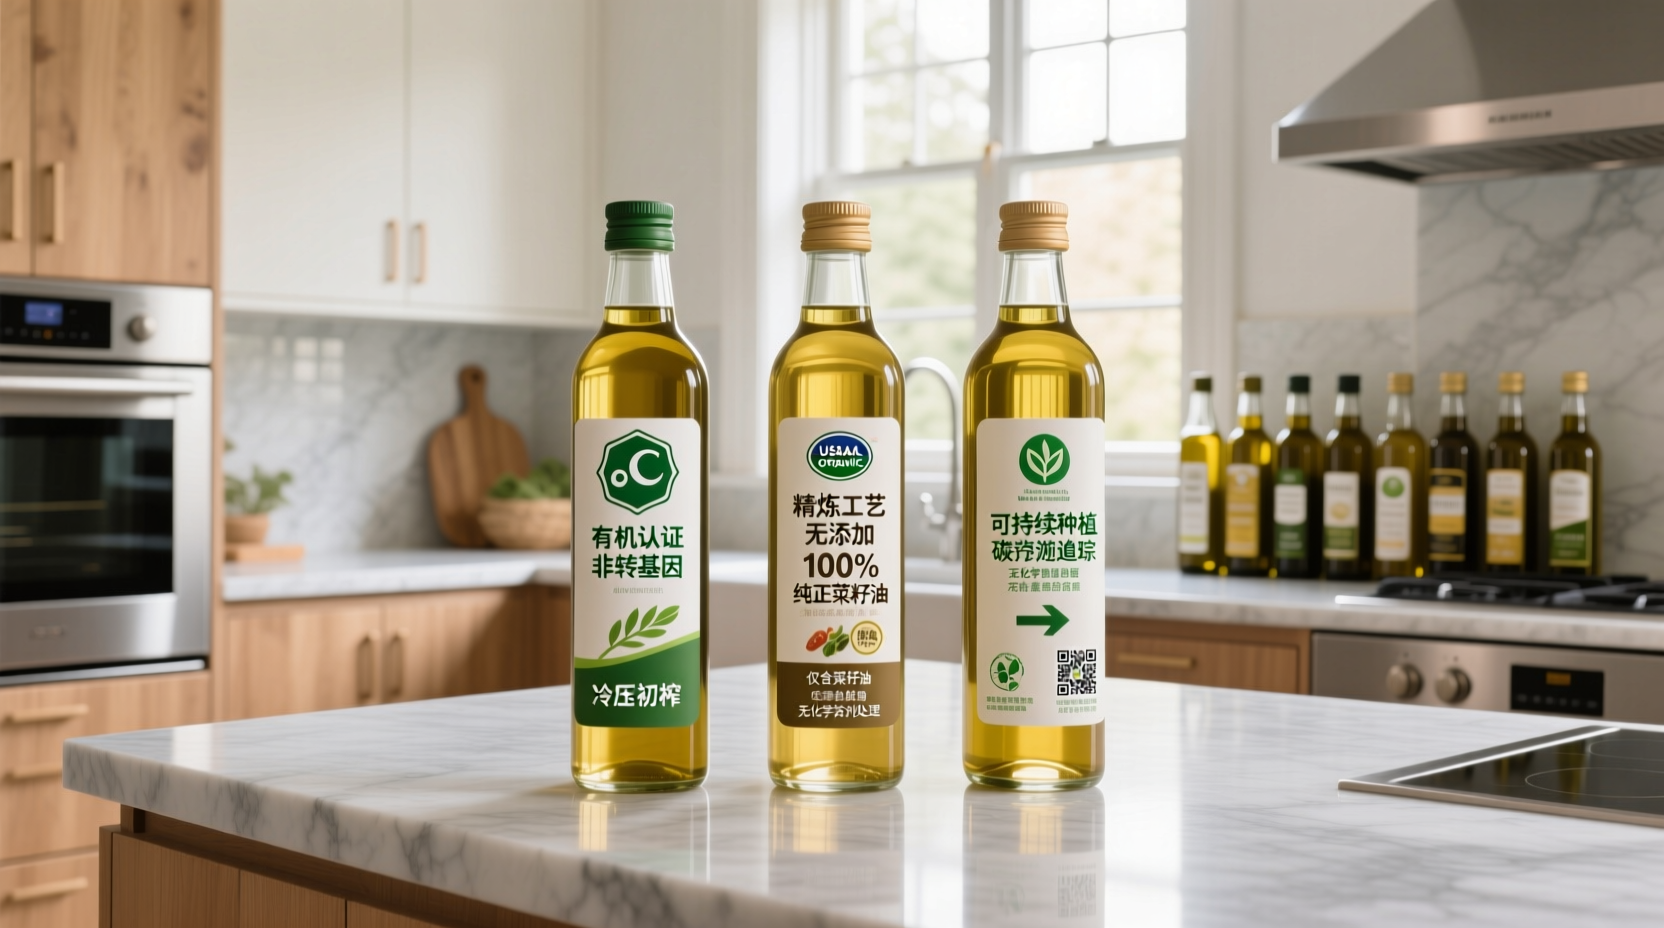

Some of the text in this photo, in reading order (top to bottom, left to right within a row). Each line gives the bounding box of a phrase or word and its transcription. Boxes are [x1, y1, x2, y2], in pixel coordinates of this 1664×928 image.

[793, 492, 886, 518] 精炼工艺
[805, 522, 874, 546] 无添加
[990, 511, 1098, 536] 可持续种植
[592, 525, 684, 549] 有机认证
[592, 553, 682, 578] 非转基因
[803, 552, 879, 578] 100%
[793, 582, 888, 605] 纯正菜籽油
[592, 683, 681, 707] 冷压初榨
